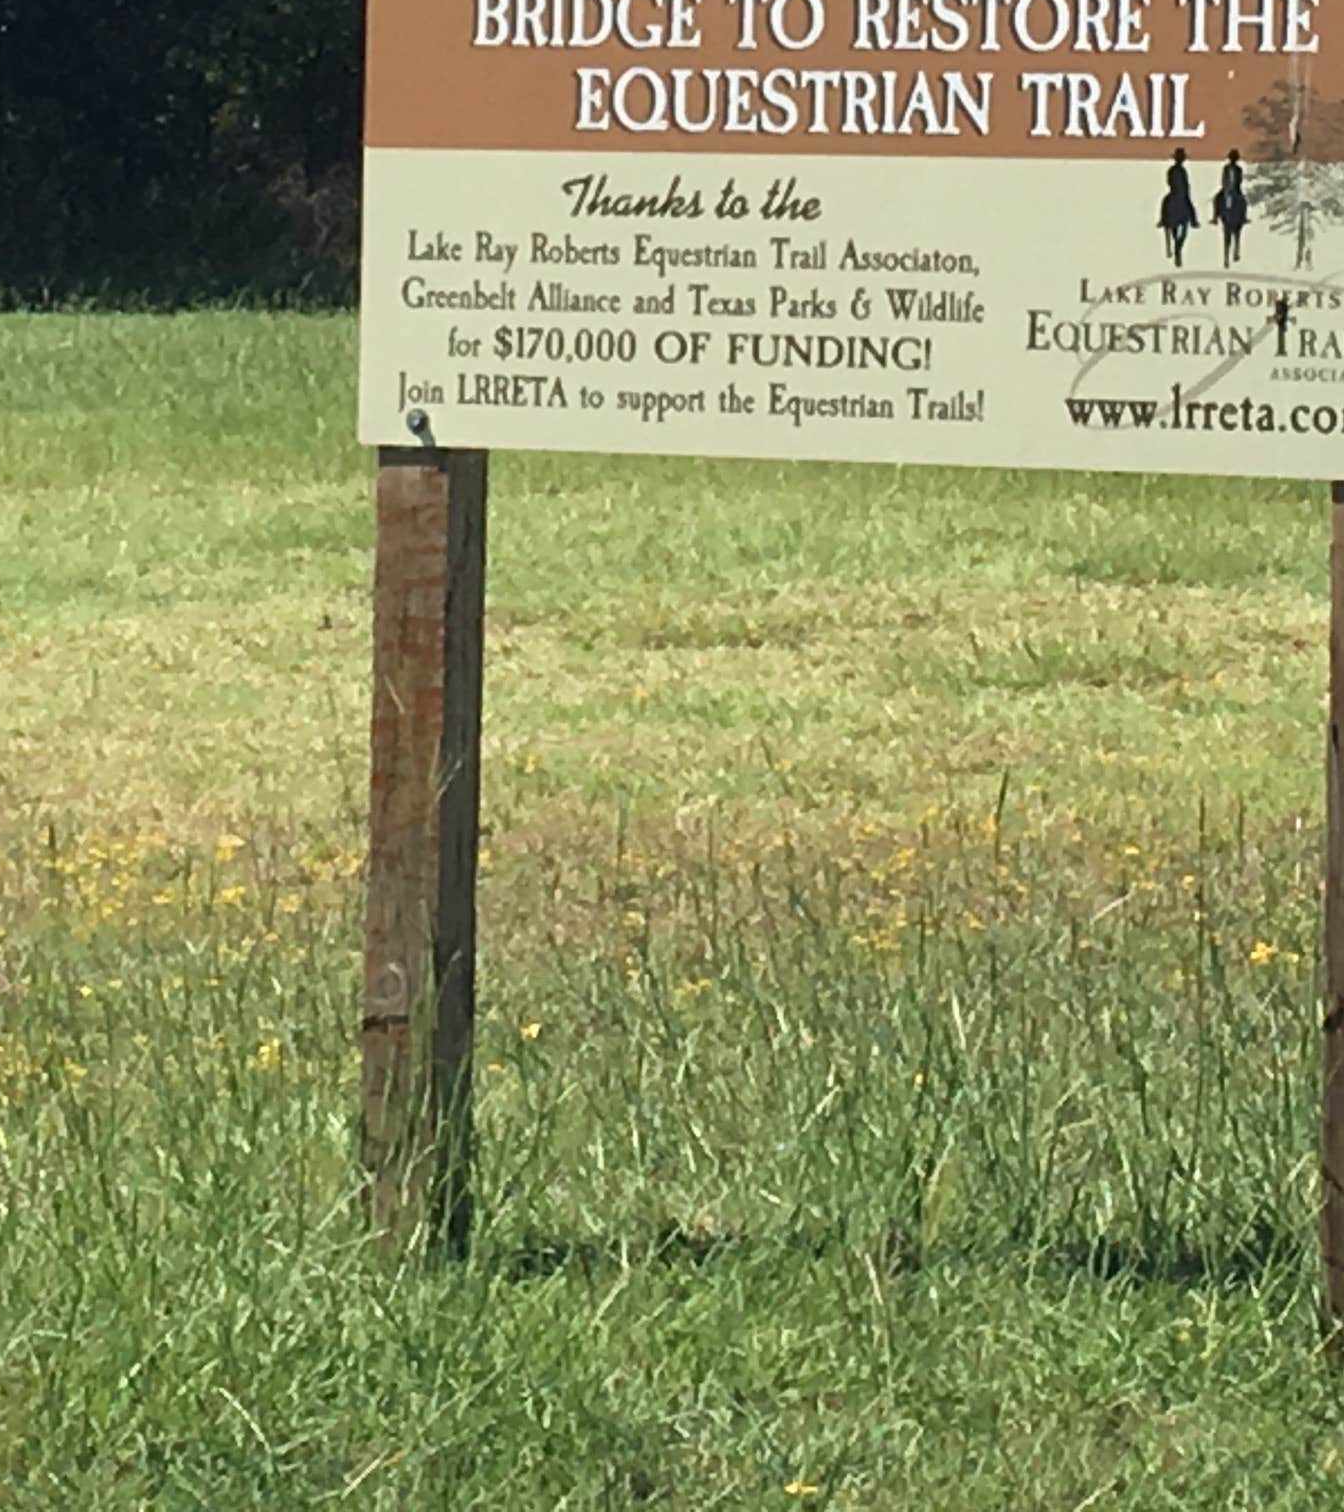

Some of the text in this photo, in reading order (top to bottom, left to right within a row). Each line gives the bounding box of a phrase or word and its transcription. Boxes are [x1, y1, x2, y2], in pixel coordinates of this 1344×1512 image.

[575, 67, 1205, 138] EQUESTRIAN TRAIL
[561, 173, 822, 221] Thanks to the
[407, 229, 463, 261] Lake
[475, 231, 518, 273] Ray
[531, 232, 620, 265] Roberts
[634, 234, 757, 277] Equestrian
[770, 237, 827, 270] Trail
[401, 276, 985, 323] Greenbelt Alliance and Texas Parks & Wildlife
[1079, 278, 1146, 305] LAKE
[1161, 281, 1212, 306] RAY
[448, 326, 482, 357] for
[655, 331, 711, 364] OF
[727, 333, 932, 371] FUNDING!
[1026, 310, 1253, 356] EQUESTRIAN
[398, 371, 985, 427] Join LRRETA to support the Equestrian Trails!
